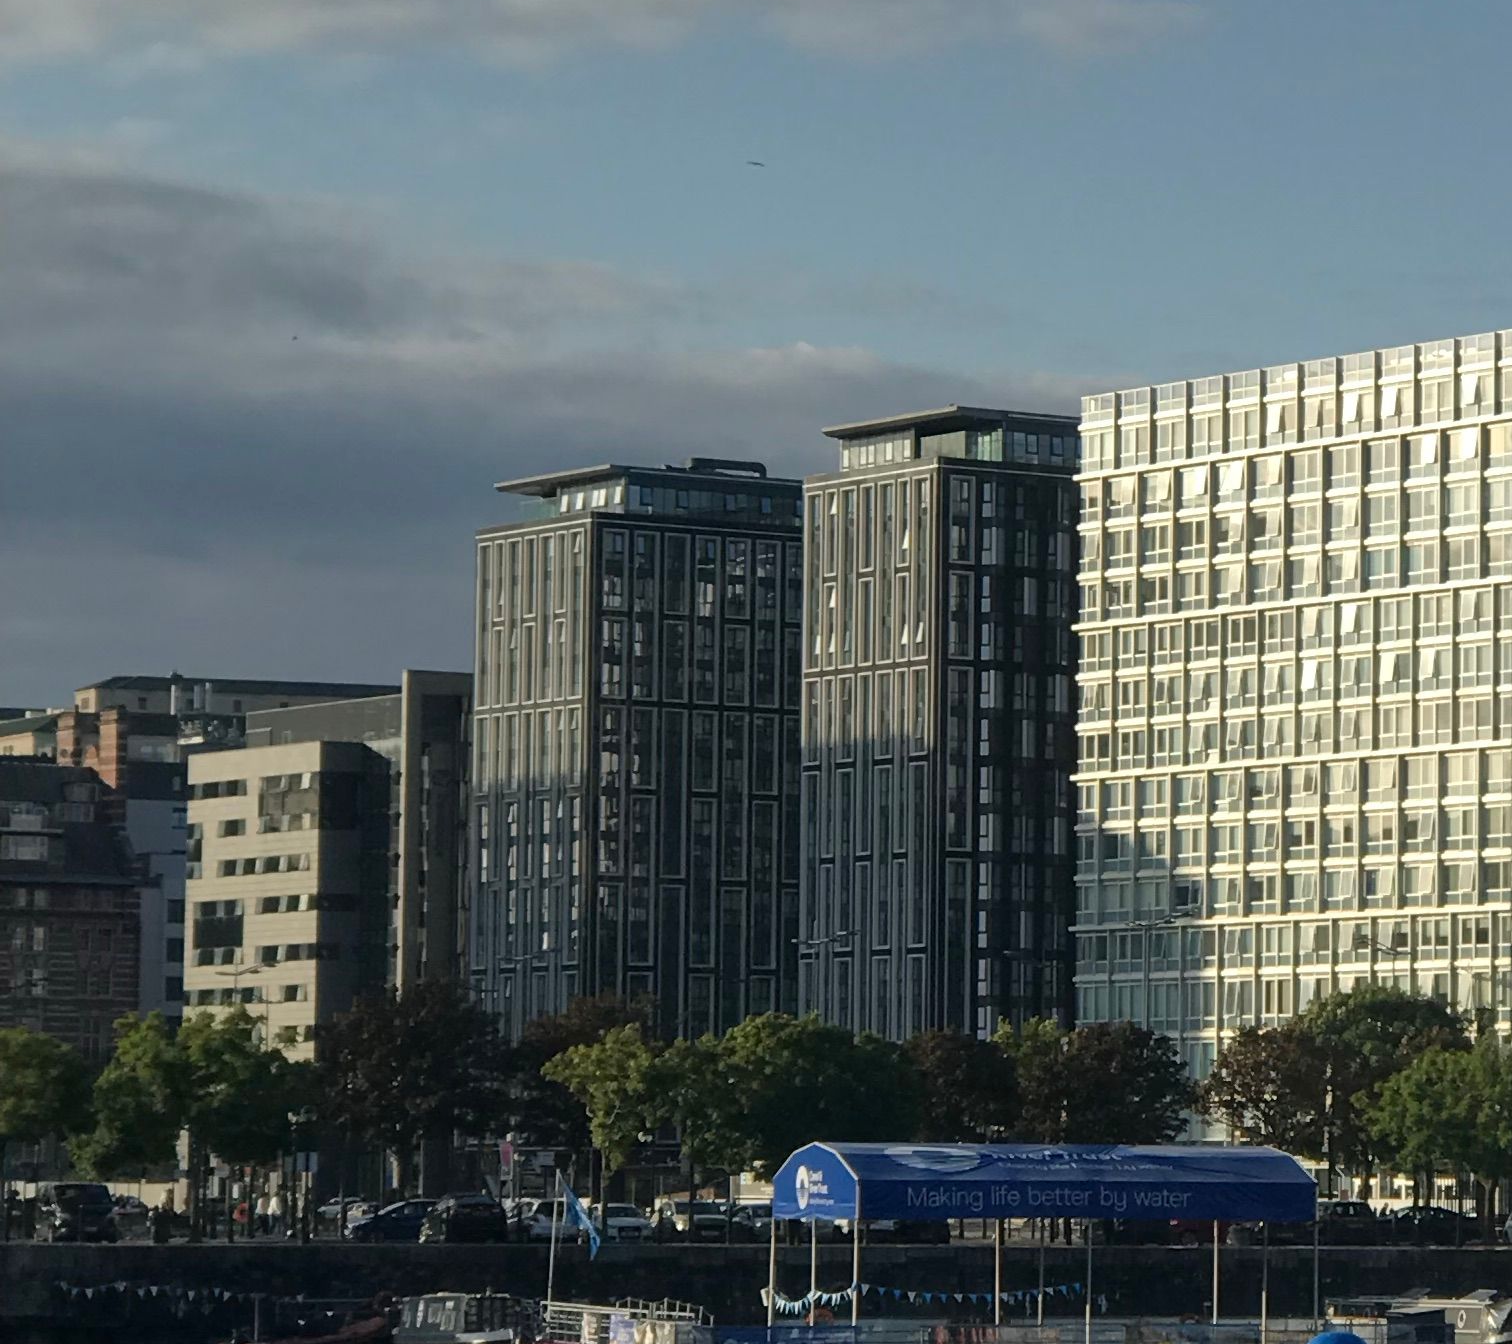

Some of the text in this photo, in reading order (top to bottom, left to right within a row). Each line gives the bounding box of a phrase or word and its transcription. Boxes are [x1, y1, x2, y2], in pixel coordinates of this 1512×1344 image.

[907, 1185, 1192, 1211] Making life better by water
